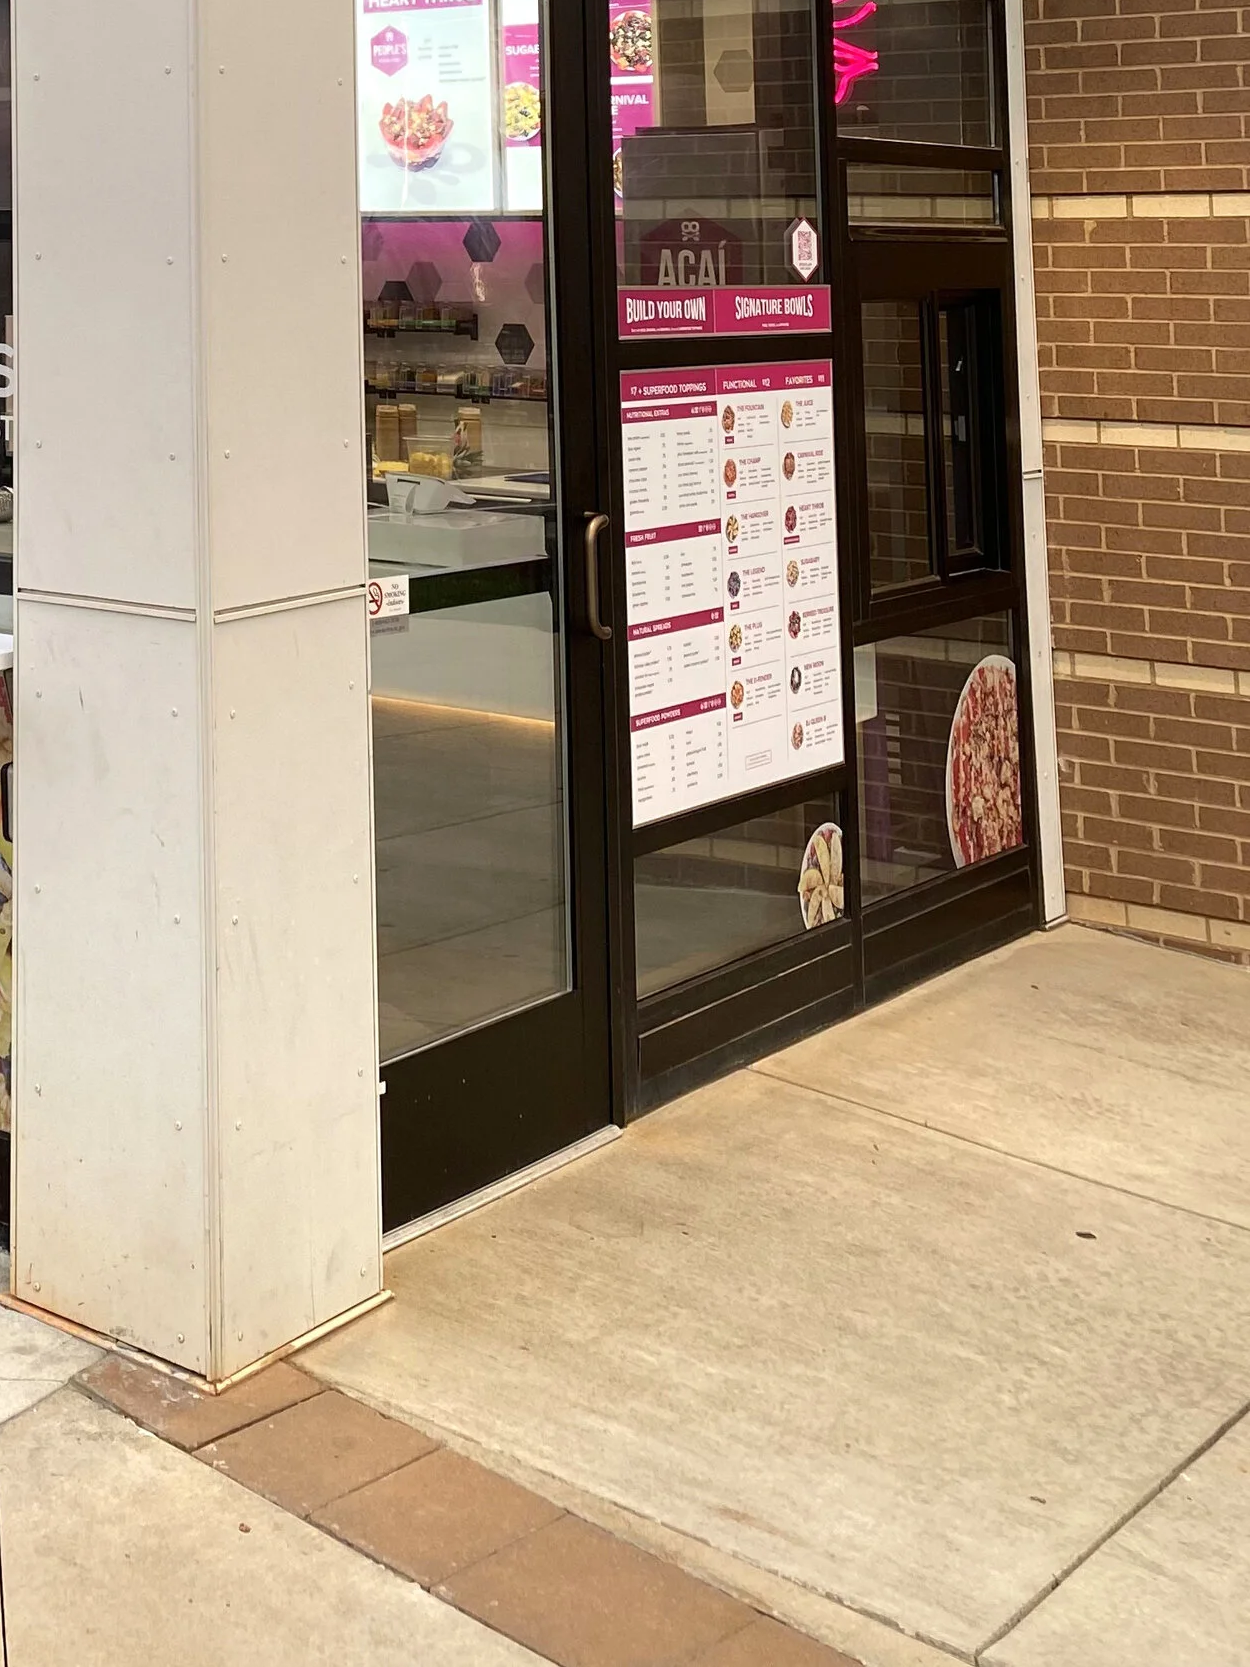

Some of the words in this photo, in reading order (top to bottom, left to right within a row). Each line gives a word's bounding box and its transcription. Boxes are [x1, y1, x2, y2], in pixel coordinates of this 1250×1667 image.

[626, 297, 656, 324] BUILD
[656, 300, 683, 320] YOUR
[684, 296, 707, 322] OWN
[735, 295, 783, 321] SIGNATURE
[784, 294, 814, 318] BOWLS
[723, 379, 757, 390] FUNCTIONAL
[785, 375, 813, 385] FAVORITES
[643, 384, 678, 396] SUPERFOOD
[679, 382, 707, 393] TOPPINGS
[630, 534, 644, 542] FRESH
[644, 532, 657, 540] FRUIT
[633, 626, 652, 636] NATURAL
[653, 622, 671, 632] SPREADS
[635, 714, 660, 727] SUPERFOOD
[661, 709, 681, 720] POWDERS
